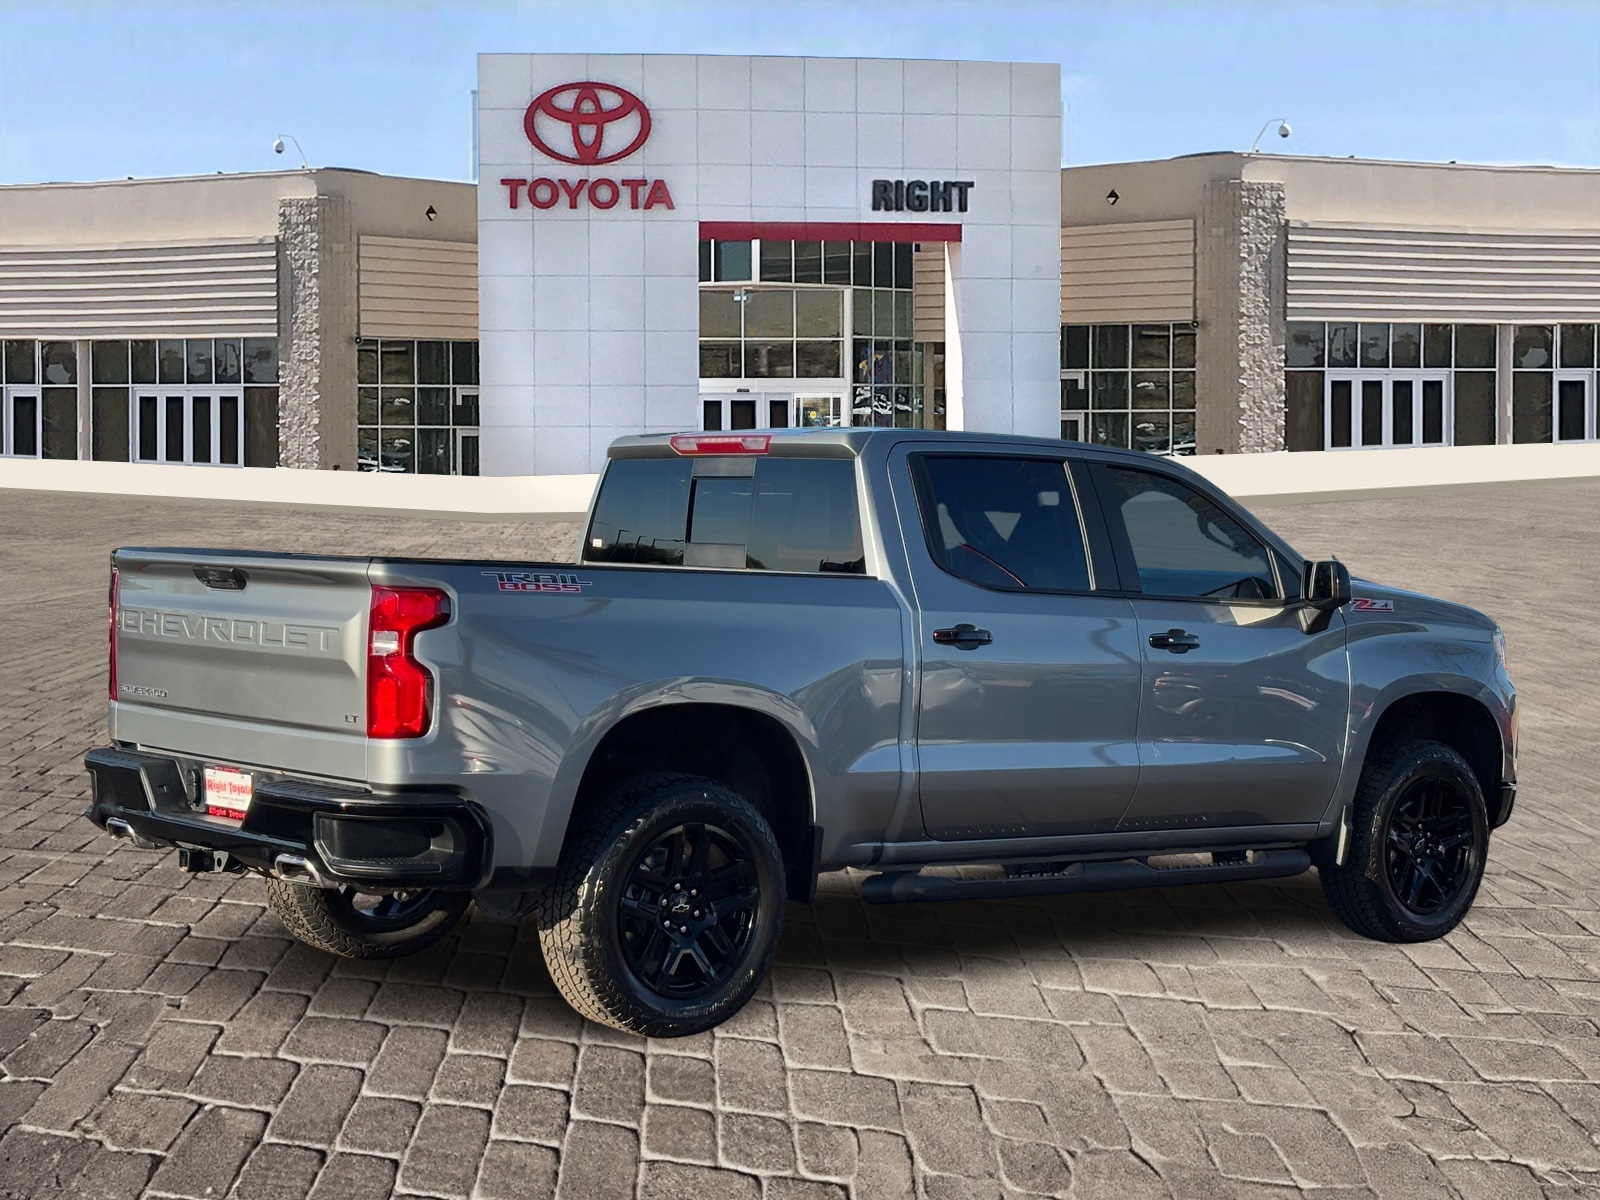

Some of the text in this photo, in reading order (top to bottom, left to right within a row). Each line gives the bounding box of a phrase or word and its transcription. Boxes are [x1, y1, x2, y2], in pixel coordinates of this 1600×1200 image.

[500, 178, 675, 210] TOYOTA
[872, 179, 974, 212] RIGHT
[481, 571, 592, 586] TRAIL
[498, 582, 581, 593] BOSS
[122, 609, 339, 652] CHEVROLET
[345, 714, 359, 724] LT
[207, 779, 252, 796] Right Toyota
